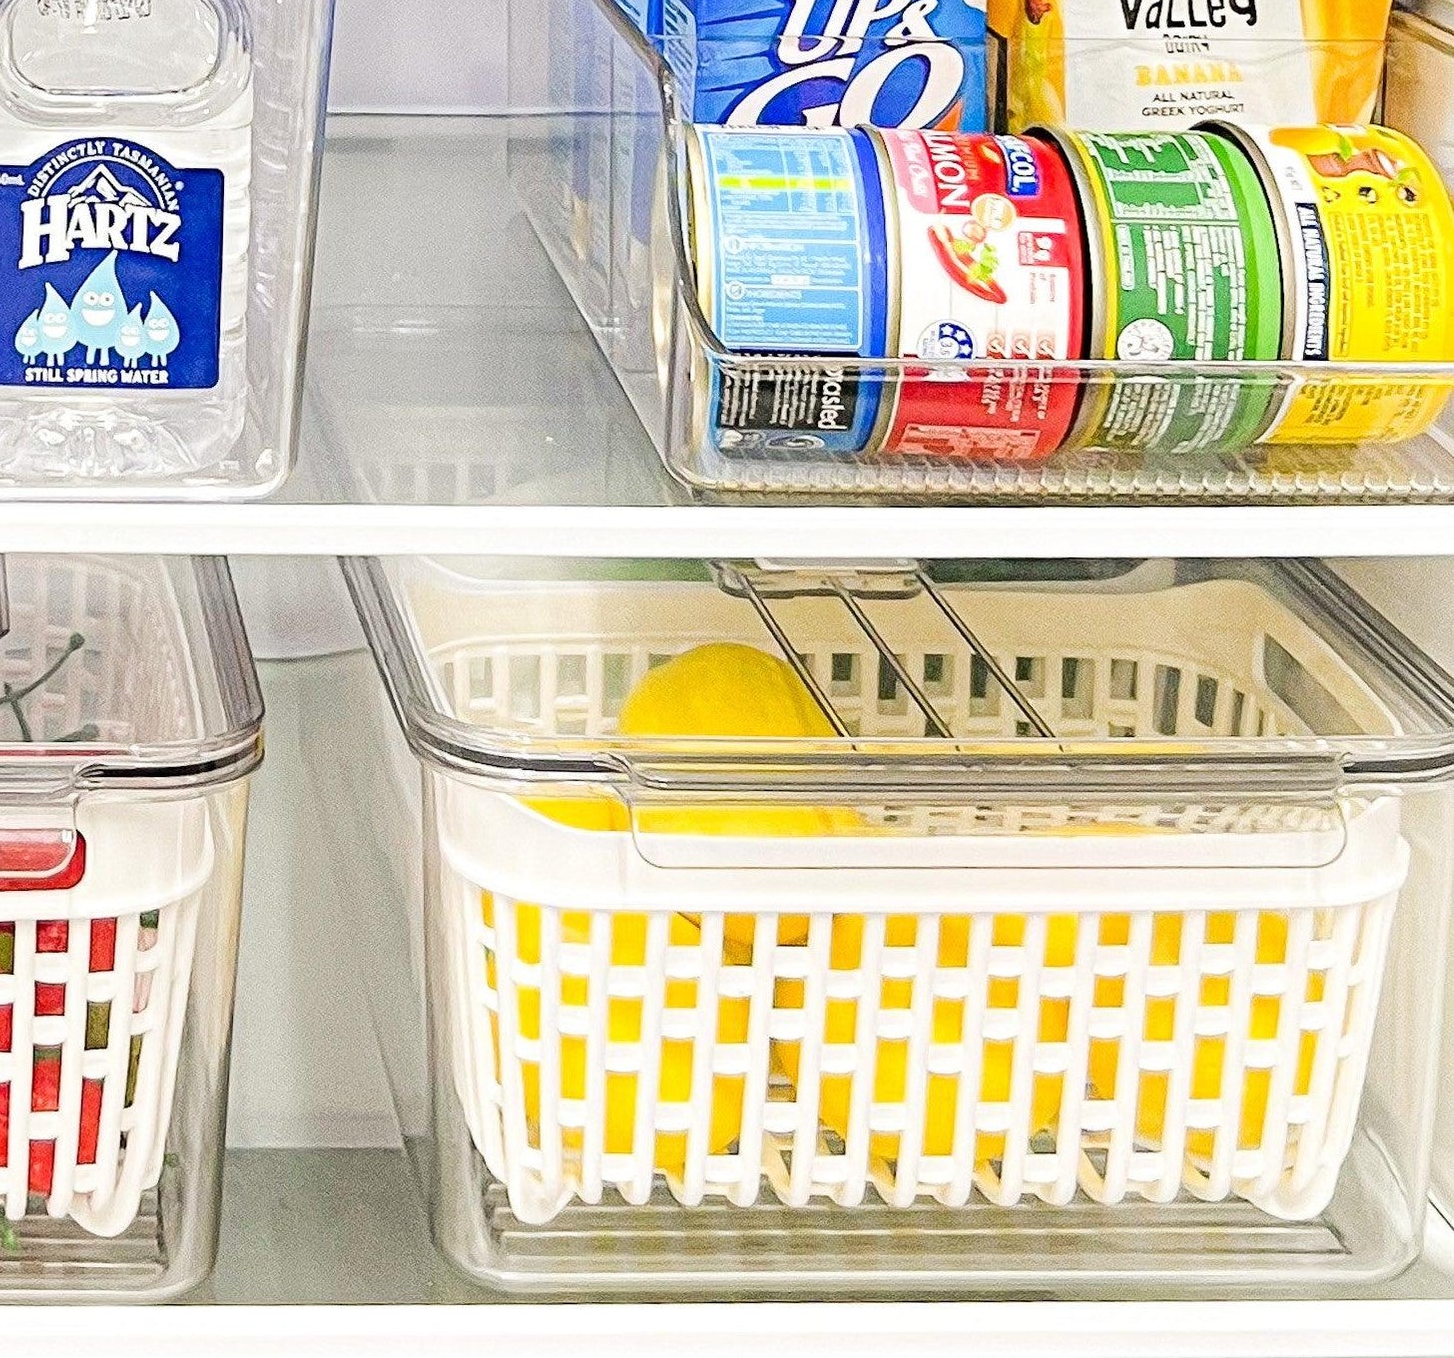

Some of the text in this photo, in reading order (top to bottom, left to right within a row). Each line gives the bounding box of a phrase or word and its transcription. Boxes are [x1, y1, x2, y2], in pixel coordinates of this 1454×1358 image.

[1134, 64, 1244, 87] BANANA
[1152, 89, 1235, 103] ALL NATURAL
[1141, 103, 1245, 118] GREEK YOGHURT
[27, 140, 180, 211] DISTINCTLY TASMANIAN
[18, 193, 183, 270] HARTZ
[1304, 282, 1326, 356] INGREDIENTS
[25, 367, 169, 384] STILL SPRING WATER
